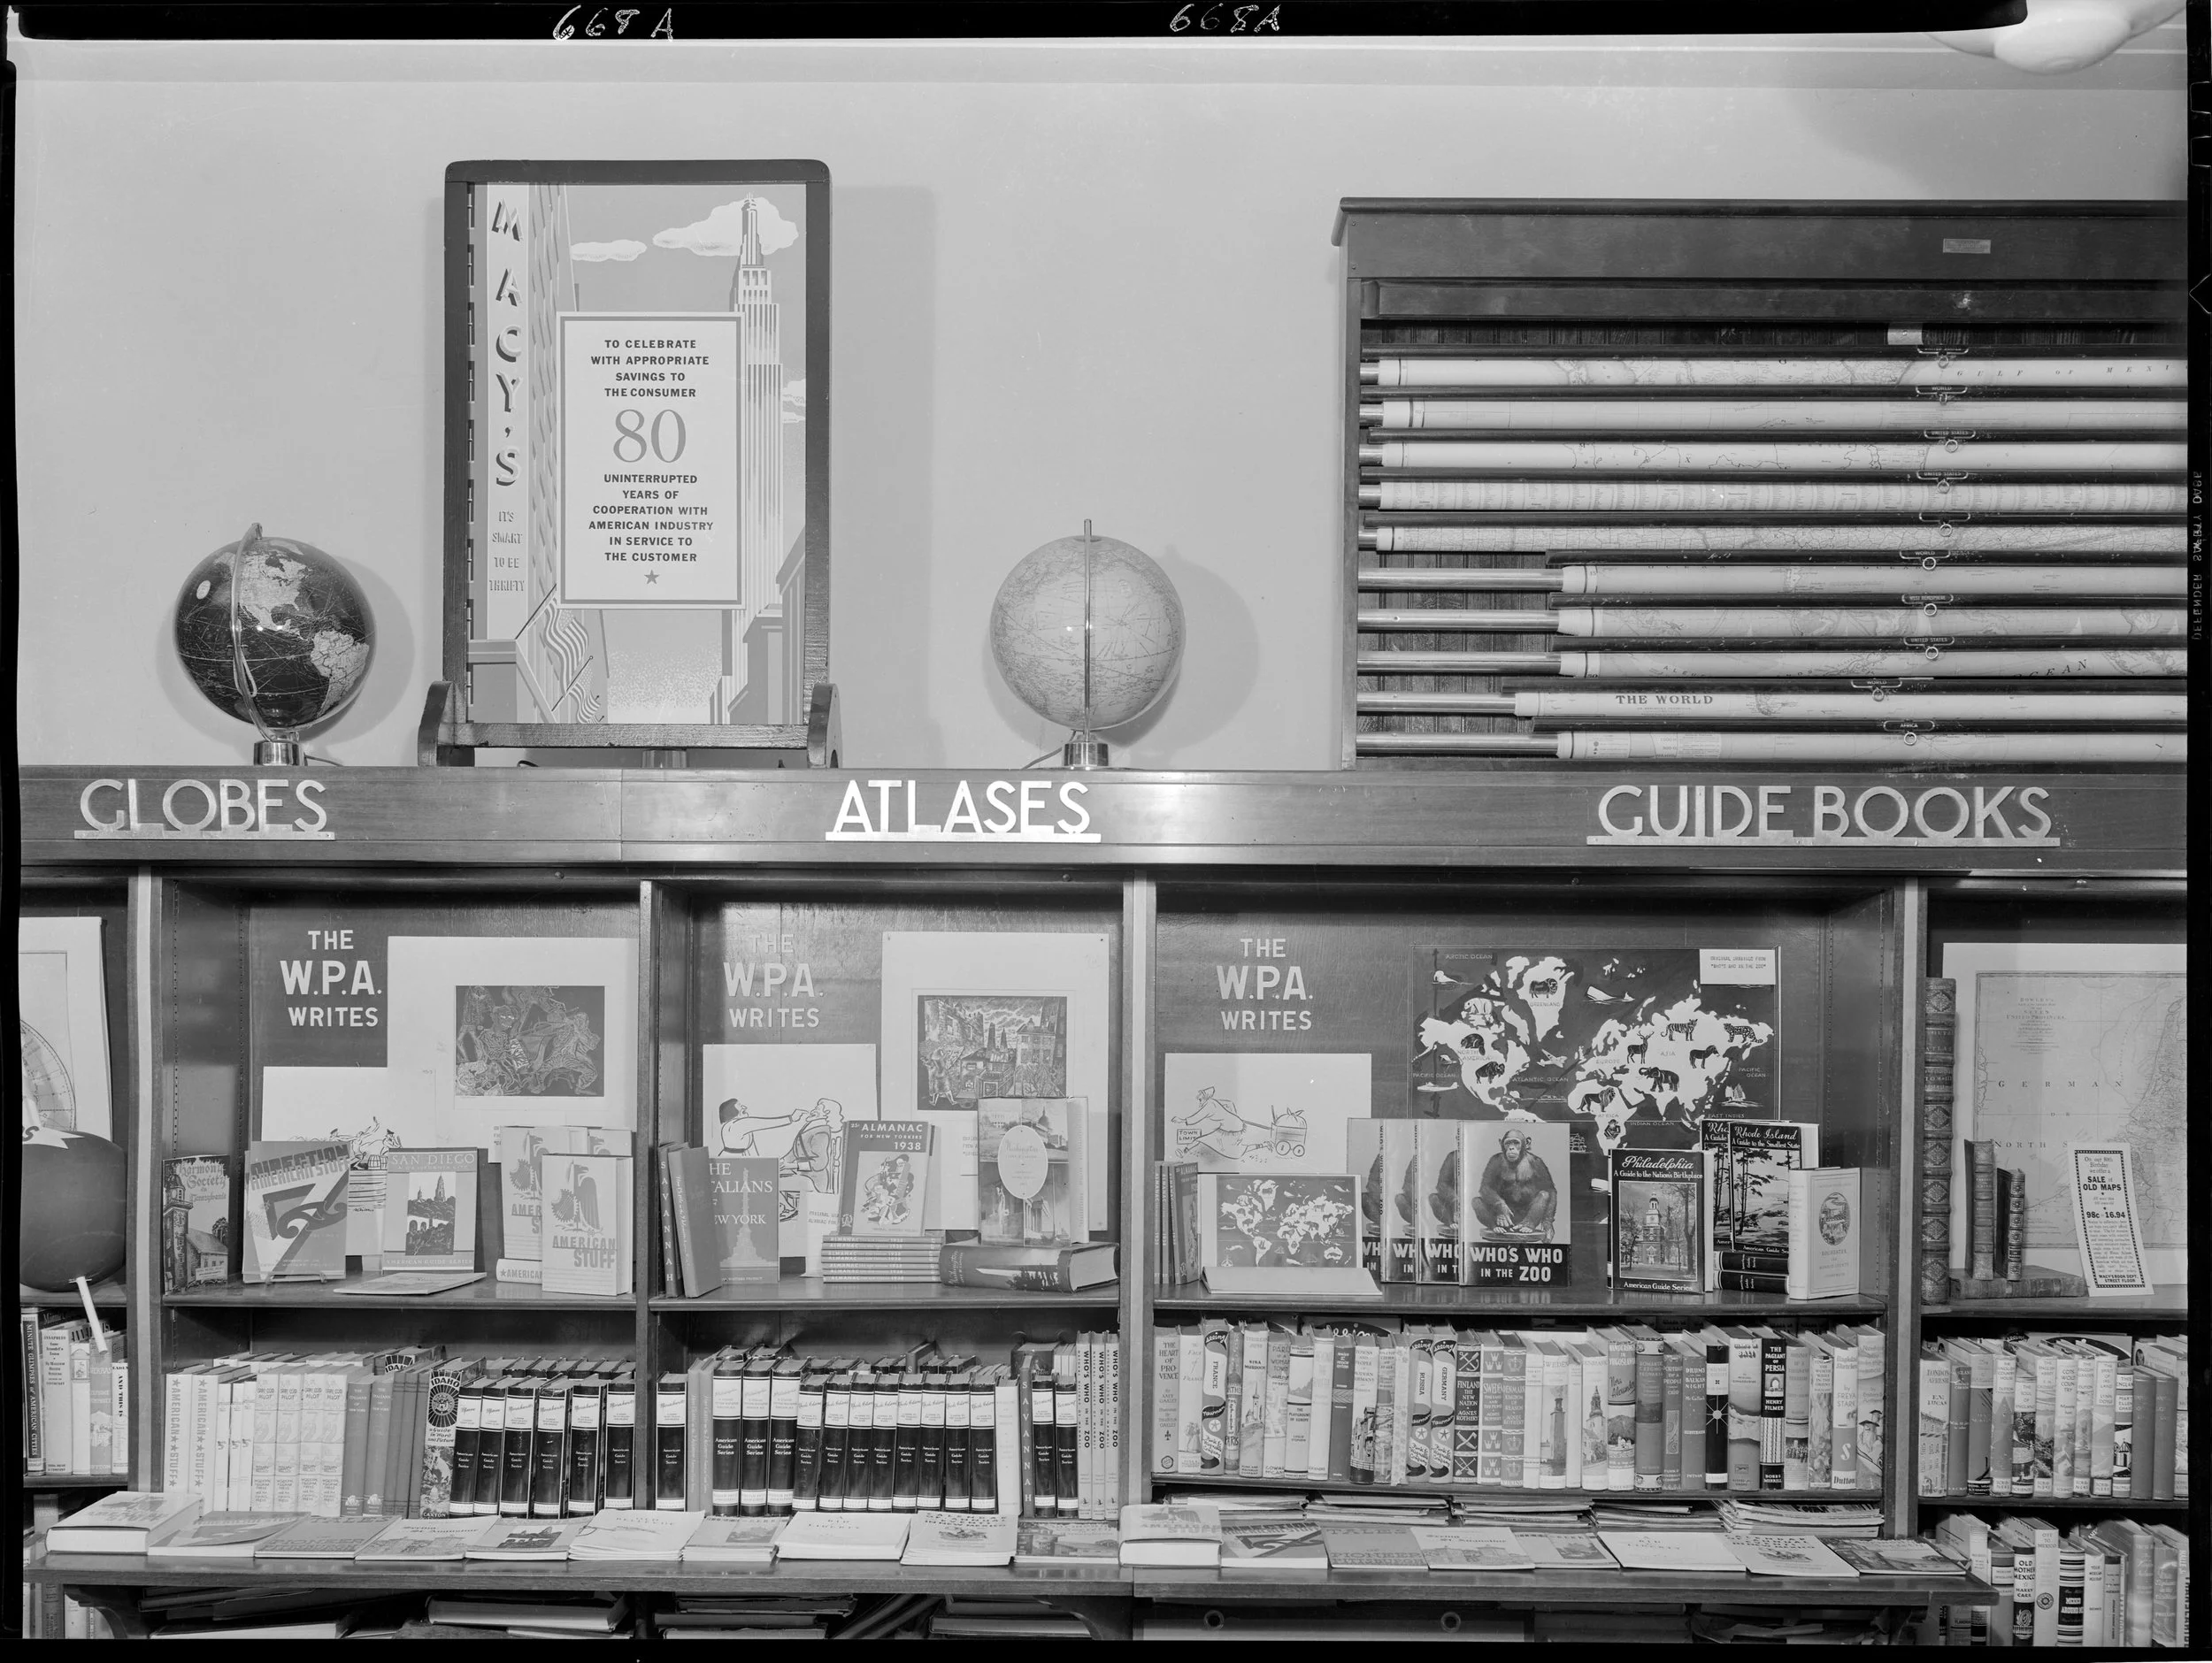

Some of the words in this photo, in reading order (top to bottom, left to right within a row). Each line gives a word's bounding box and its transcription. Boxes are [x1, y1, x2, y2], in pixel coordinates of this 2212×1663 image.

[605, 340, 619, 349] TO
[626, 340, 696, 349] CELEBRATE
[591, 356, 620, 365] WITH
[626, 356, 709, 365] APPROPRIATE
[616, 372, 665, 381] SAVINGS
[670, 372, 685, 381] TO
[605, 388, 627, 397] THE
[630, 388, 695, 397] CONSUMER
[613, 409, 686, 463] 80
[604, 474, 697, 484] UNINTERRUPTED
[664, 491, 679, 500] OF
[593, 506, 674, 515] COOPERATION
[679, 506, 708, 515] WITH
[589, 521, 649, 530] AMERICAN
[655, 521, 713, 531] INDUSTRY
[493, 533, 522, 544] SMART
[610, 537, 622, 546] IN
[626, 537, 673, 546] SERVICE
[495, 557, 504, 567] TO
[605, 553, 627, 562] THE
[632, 553, 697, 562] CUSTOMER
[489, 580, 525, 591] THRIFTY
[1616, 695, 1651, 704] THE
[1656, 694, 1713, 704] WORLD
[80, 778, 328, 836] GLOBES
[832, 779, 1092, 836] ATLASES
[1598, 785, 1794, 839] GUIDE
[1814, 786, 2052, 840] BOOKS
[308, 930, 354, 950] THE
[750, 933, 795, 953] THE
[1240, 939, 1286, 958] THE
[280, 960, 381, 994] W.P.A.
[723, 962, 825, 998] W.P.A.
[1217, 965, 1313, 1000] W.P.A.
[288, 1007, 379, 1027] WRITES
[728, 1008, 819, 1028] WRITES
[1221, 1011, 1311, 1031] WRITES
[862, 1123, 923, 1133] ALMANAC
[1734, 1126, 1761, 1138] Rhode
[1763, 1129, 1797, 1139] Island
[894, 1141, 921, 1151] 1938
[250, 1144, 349, 1176] DIRECTION
[391, 1153, 419, 1165] SAN
[428, 1153, 475, 1164] DIEGO
[1622, 1155, 1694, 1170] Philadelphia
[250, 1165, 311, 1191] AMERICAN
[1674, 1171, 1702, 1181] Birthplace
[660, 1161, 673, 1281] SAVANNAH
[733, 1215, 766, 1224] YORK
[552, 1236, 616, 1249] AMERICAN
[573, 1250, 615, 1268] STUFF
[1470, 1245, 1518, 1263] WHO'S
[1525, 1247, 1563, 1263] WHO
[1481, 1268, 1491, 1277] IN
[1496, 1268, 1513, 1277] THE
[1519, 1266, 1551, 1282] ZOO
[431, 1376, 460, 1388] IDAHO
[170, 1387, 180, 1435] AMERICAN
[1022, 1382, 1032, 1502] SAVANNAH
[170, 1451, 180, 1477] STUFF
